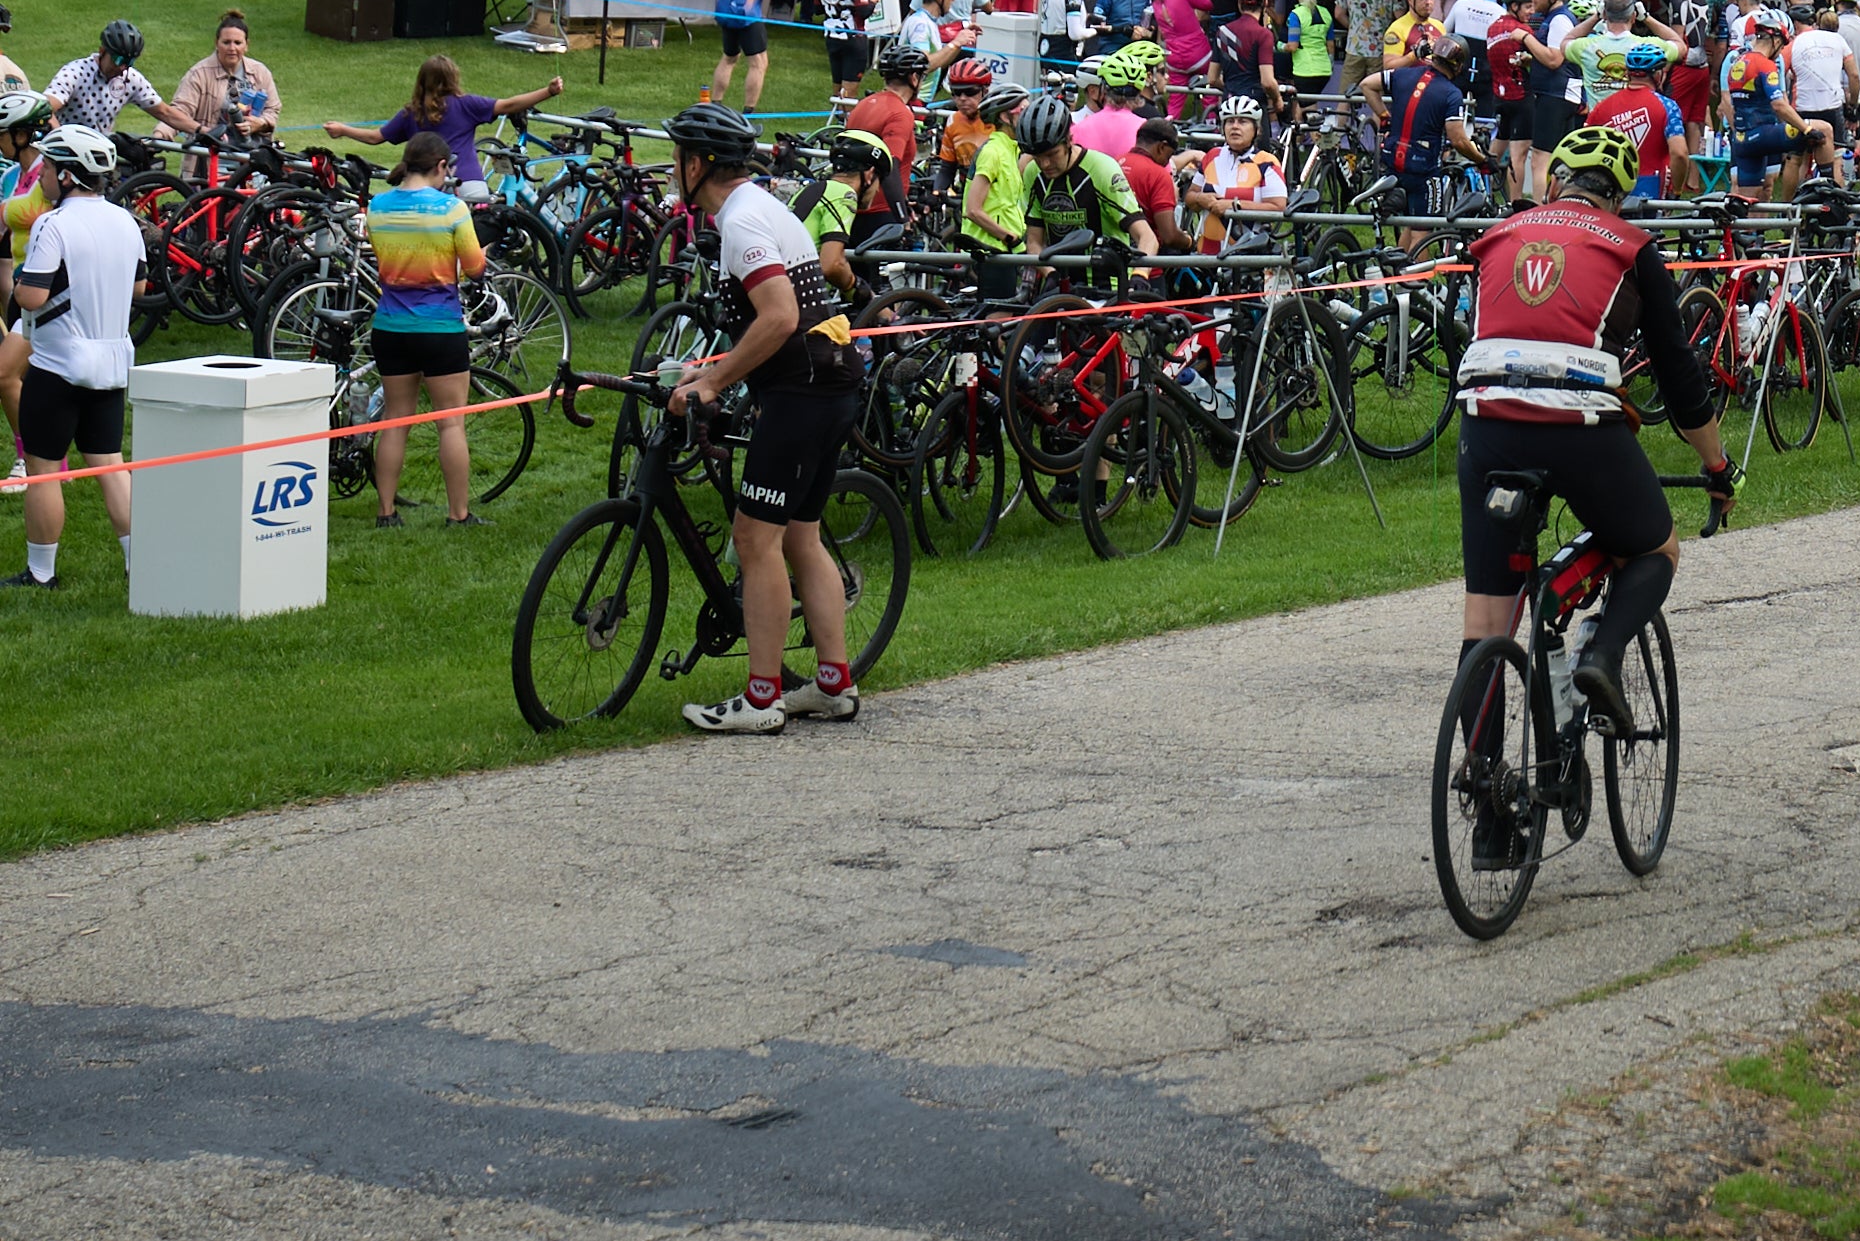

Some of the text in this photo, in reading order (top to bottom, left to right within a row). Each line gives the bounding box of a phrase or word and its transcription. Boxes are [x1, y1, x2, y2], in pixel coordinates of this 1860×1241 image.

[1612, 111, 1633, 124] TEAM
[1567, 220, 1623, 246] ROWING
[1526, 259, 1553, 292] W
[1513, 363, 1549, 375] BRIOHN
[1578, 357, 1607, 374] NORDIC
[251, 471, 318, 516] LRS
[741, 481, 786, 507] RAPHA
[756, 718, 773, 729] LAKE
